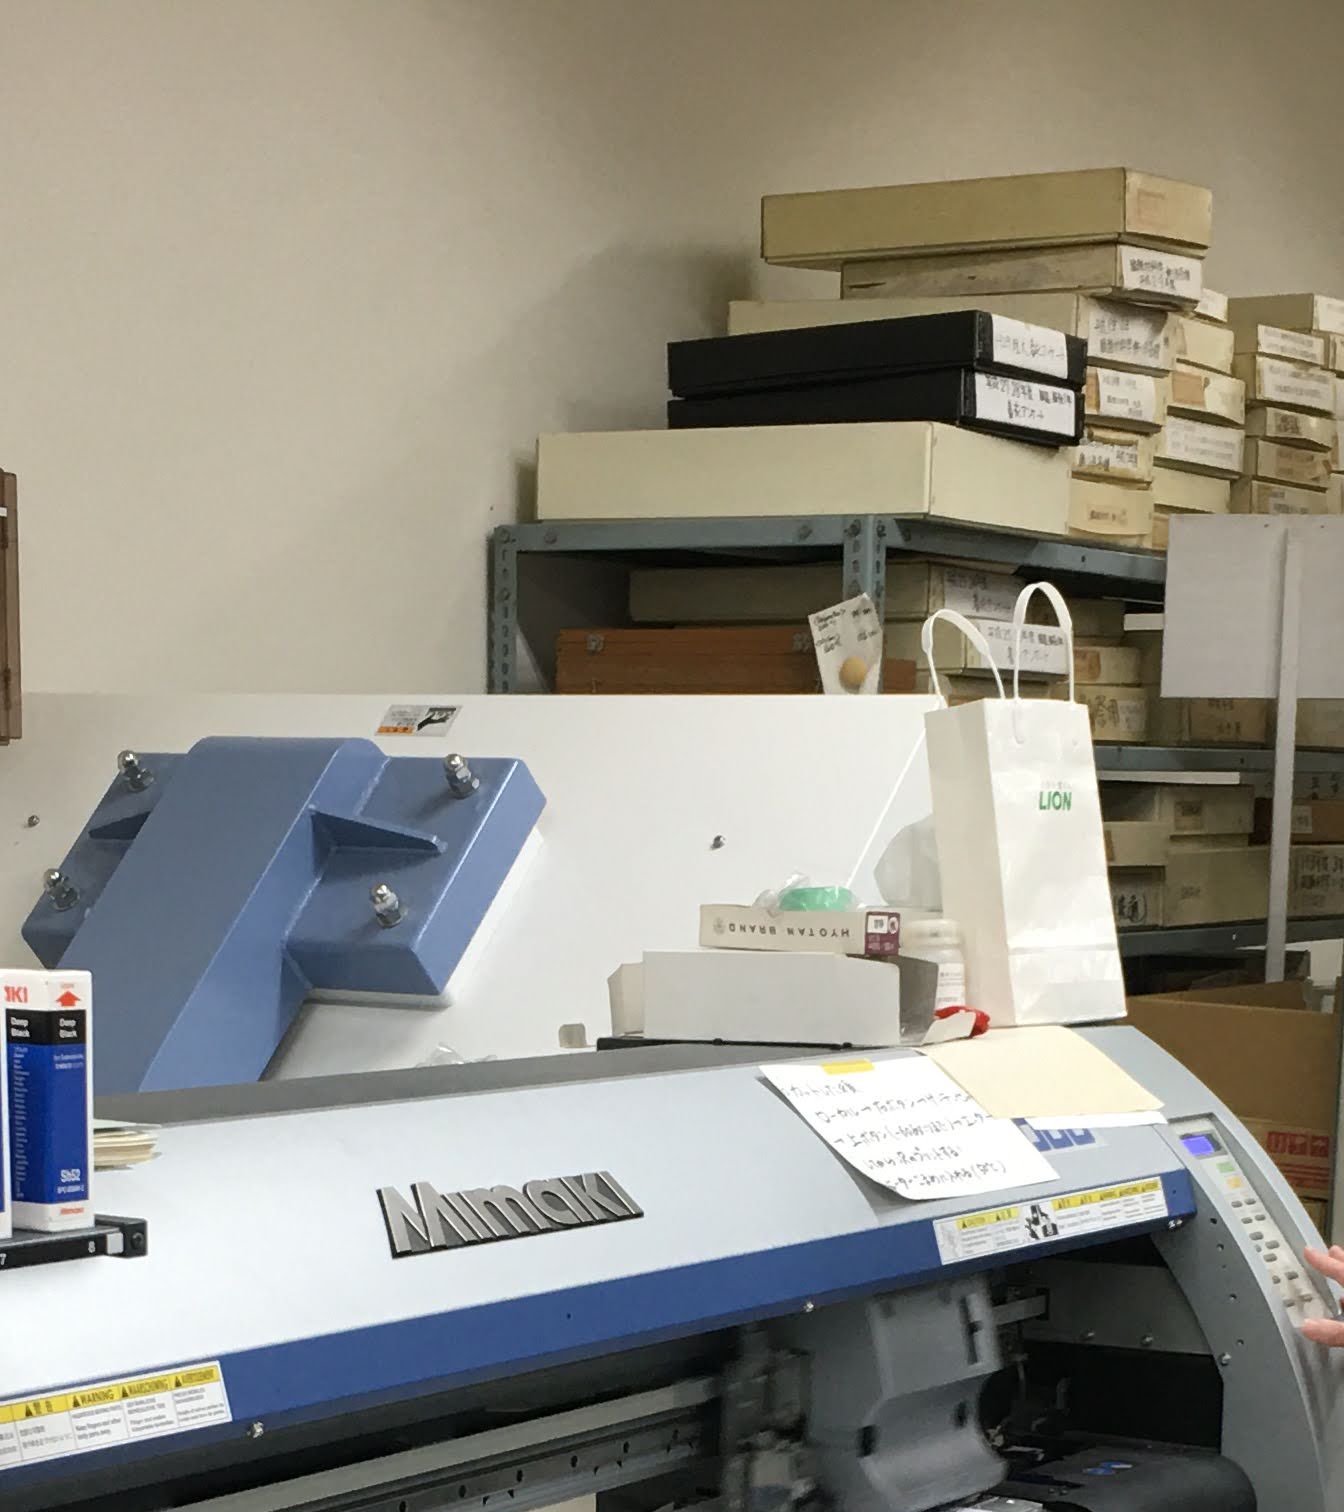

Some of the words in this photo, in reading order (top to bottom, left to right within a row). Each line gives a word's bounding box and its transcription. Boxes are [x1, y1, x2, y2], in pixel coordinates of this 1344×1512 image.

[1039, 790, 1073, 811] LION
[728, 922, 778, 937] BRAND
[787, 926, 851, 939] HYOTAN
[11, 1017, 30, 1028] Deep
[59, 1018, 77, 1028] Deep
[11, 1028, 30, 1038] Black
[59, 1028, 78, 1039] Black
[60, 1168, 82, 1183] Sb52
[375, 1170, 645, 1260] Mimaki
[87, 1240, 96, 1254] 8
[80, 1388, 115, 1405] WARNING
